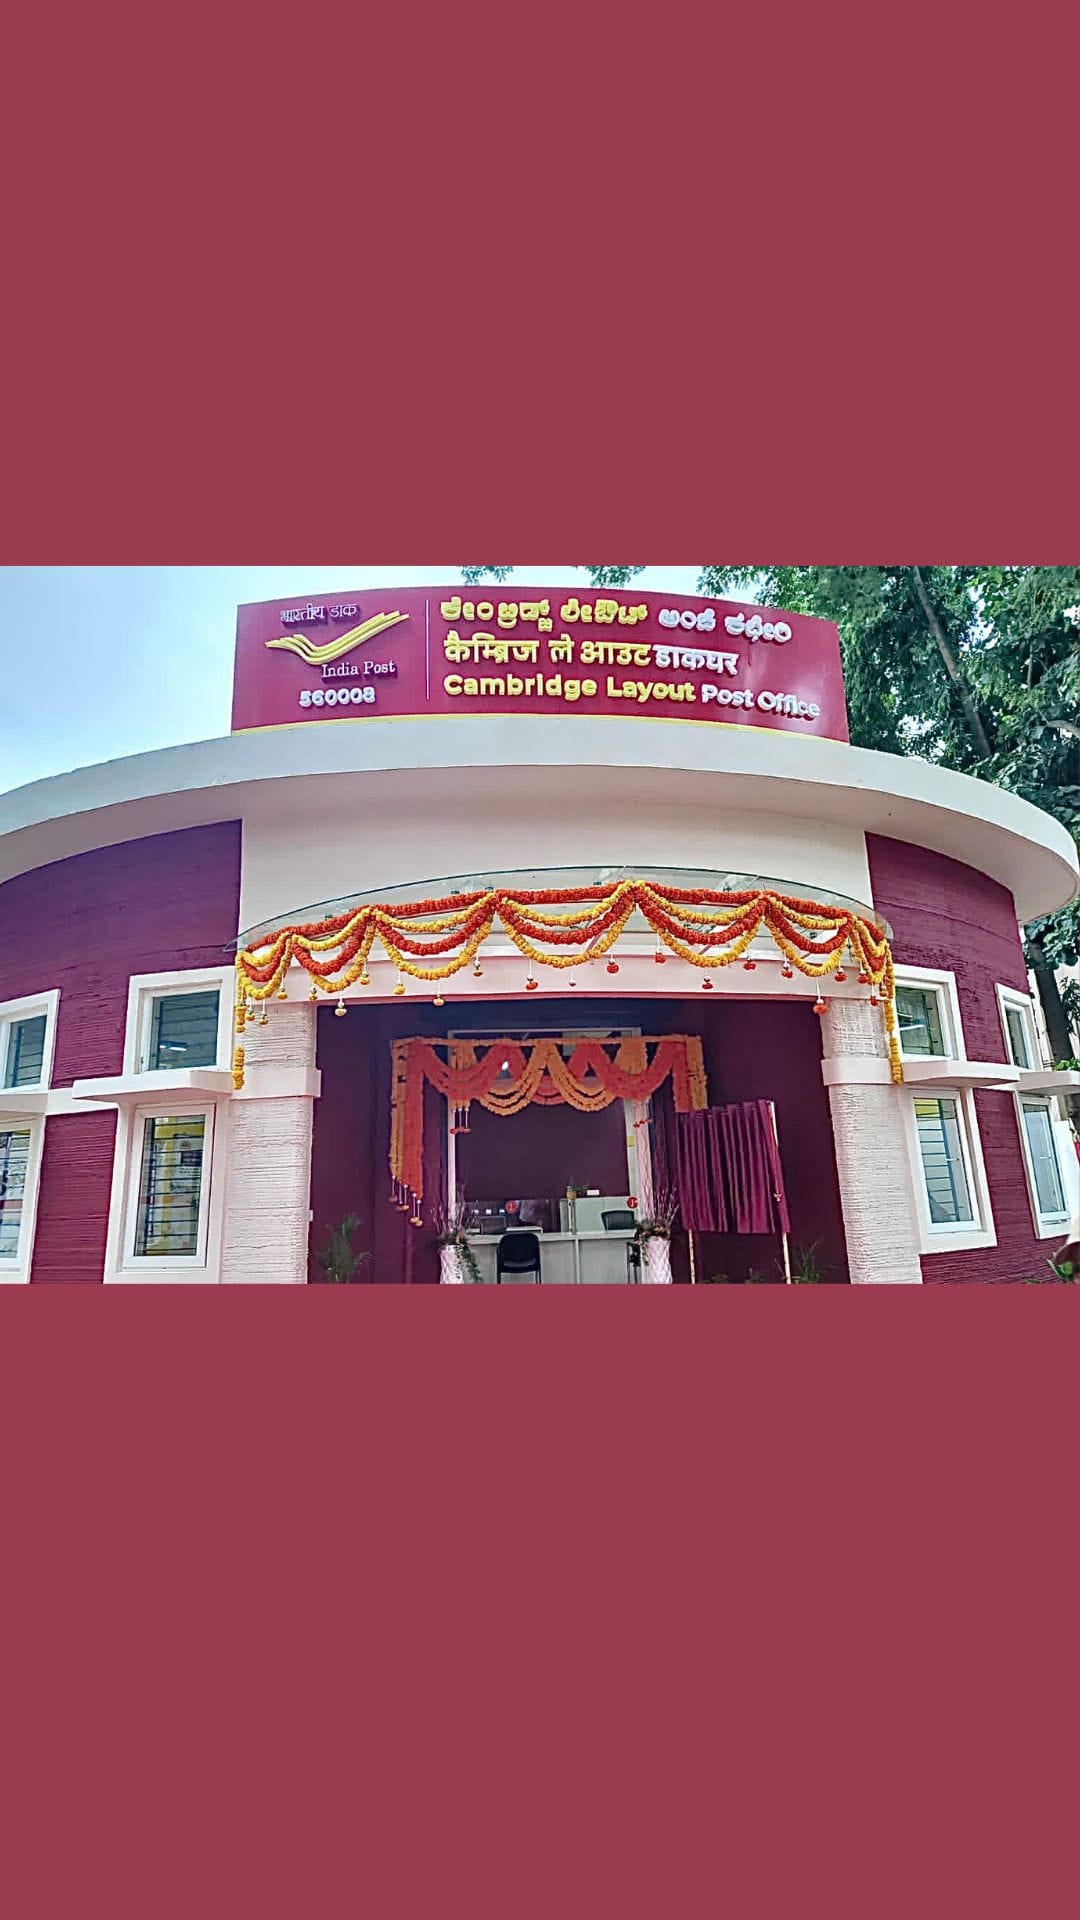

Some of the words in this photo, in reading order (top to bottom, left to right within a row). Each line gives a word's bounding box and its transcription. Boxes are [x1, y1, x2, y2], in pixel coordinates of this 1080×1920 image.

[280, 603, 325, 623] भारतीय
[330, 603, 358, 619] डाक
[658, 608, 716, 632] ಅಂಚೆ
[548, 633, 575, 664] ले
[580, 640, 652, 666] आउट
[652, 644, 740, 676] डाकघर
[321, 663, 358, 678] India
[364, 661, 396, 675] Post
[299, 686, 376, 708] 560008
[443, 673, 598, 702] Cambridge
[607, 676, 697, 703] Layout
[701, 683, 755, 707] Post
[757, 690, 821, 718] Office
